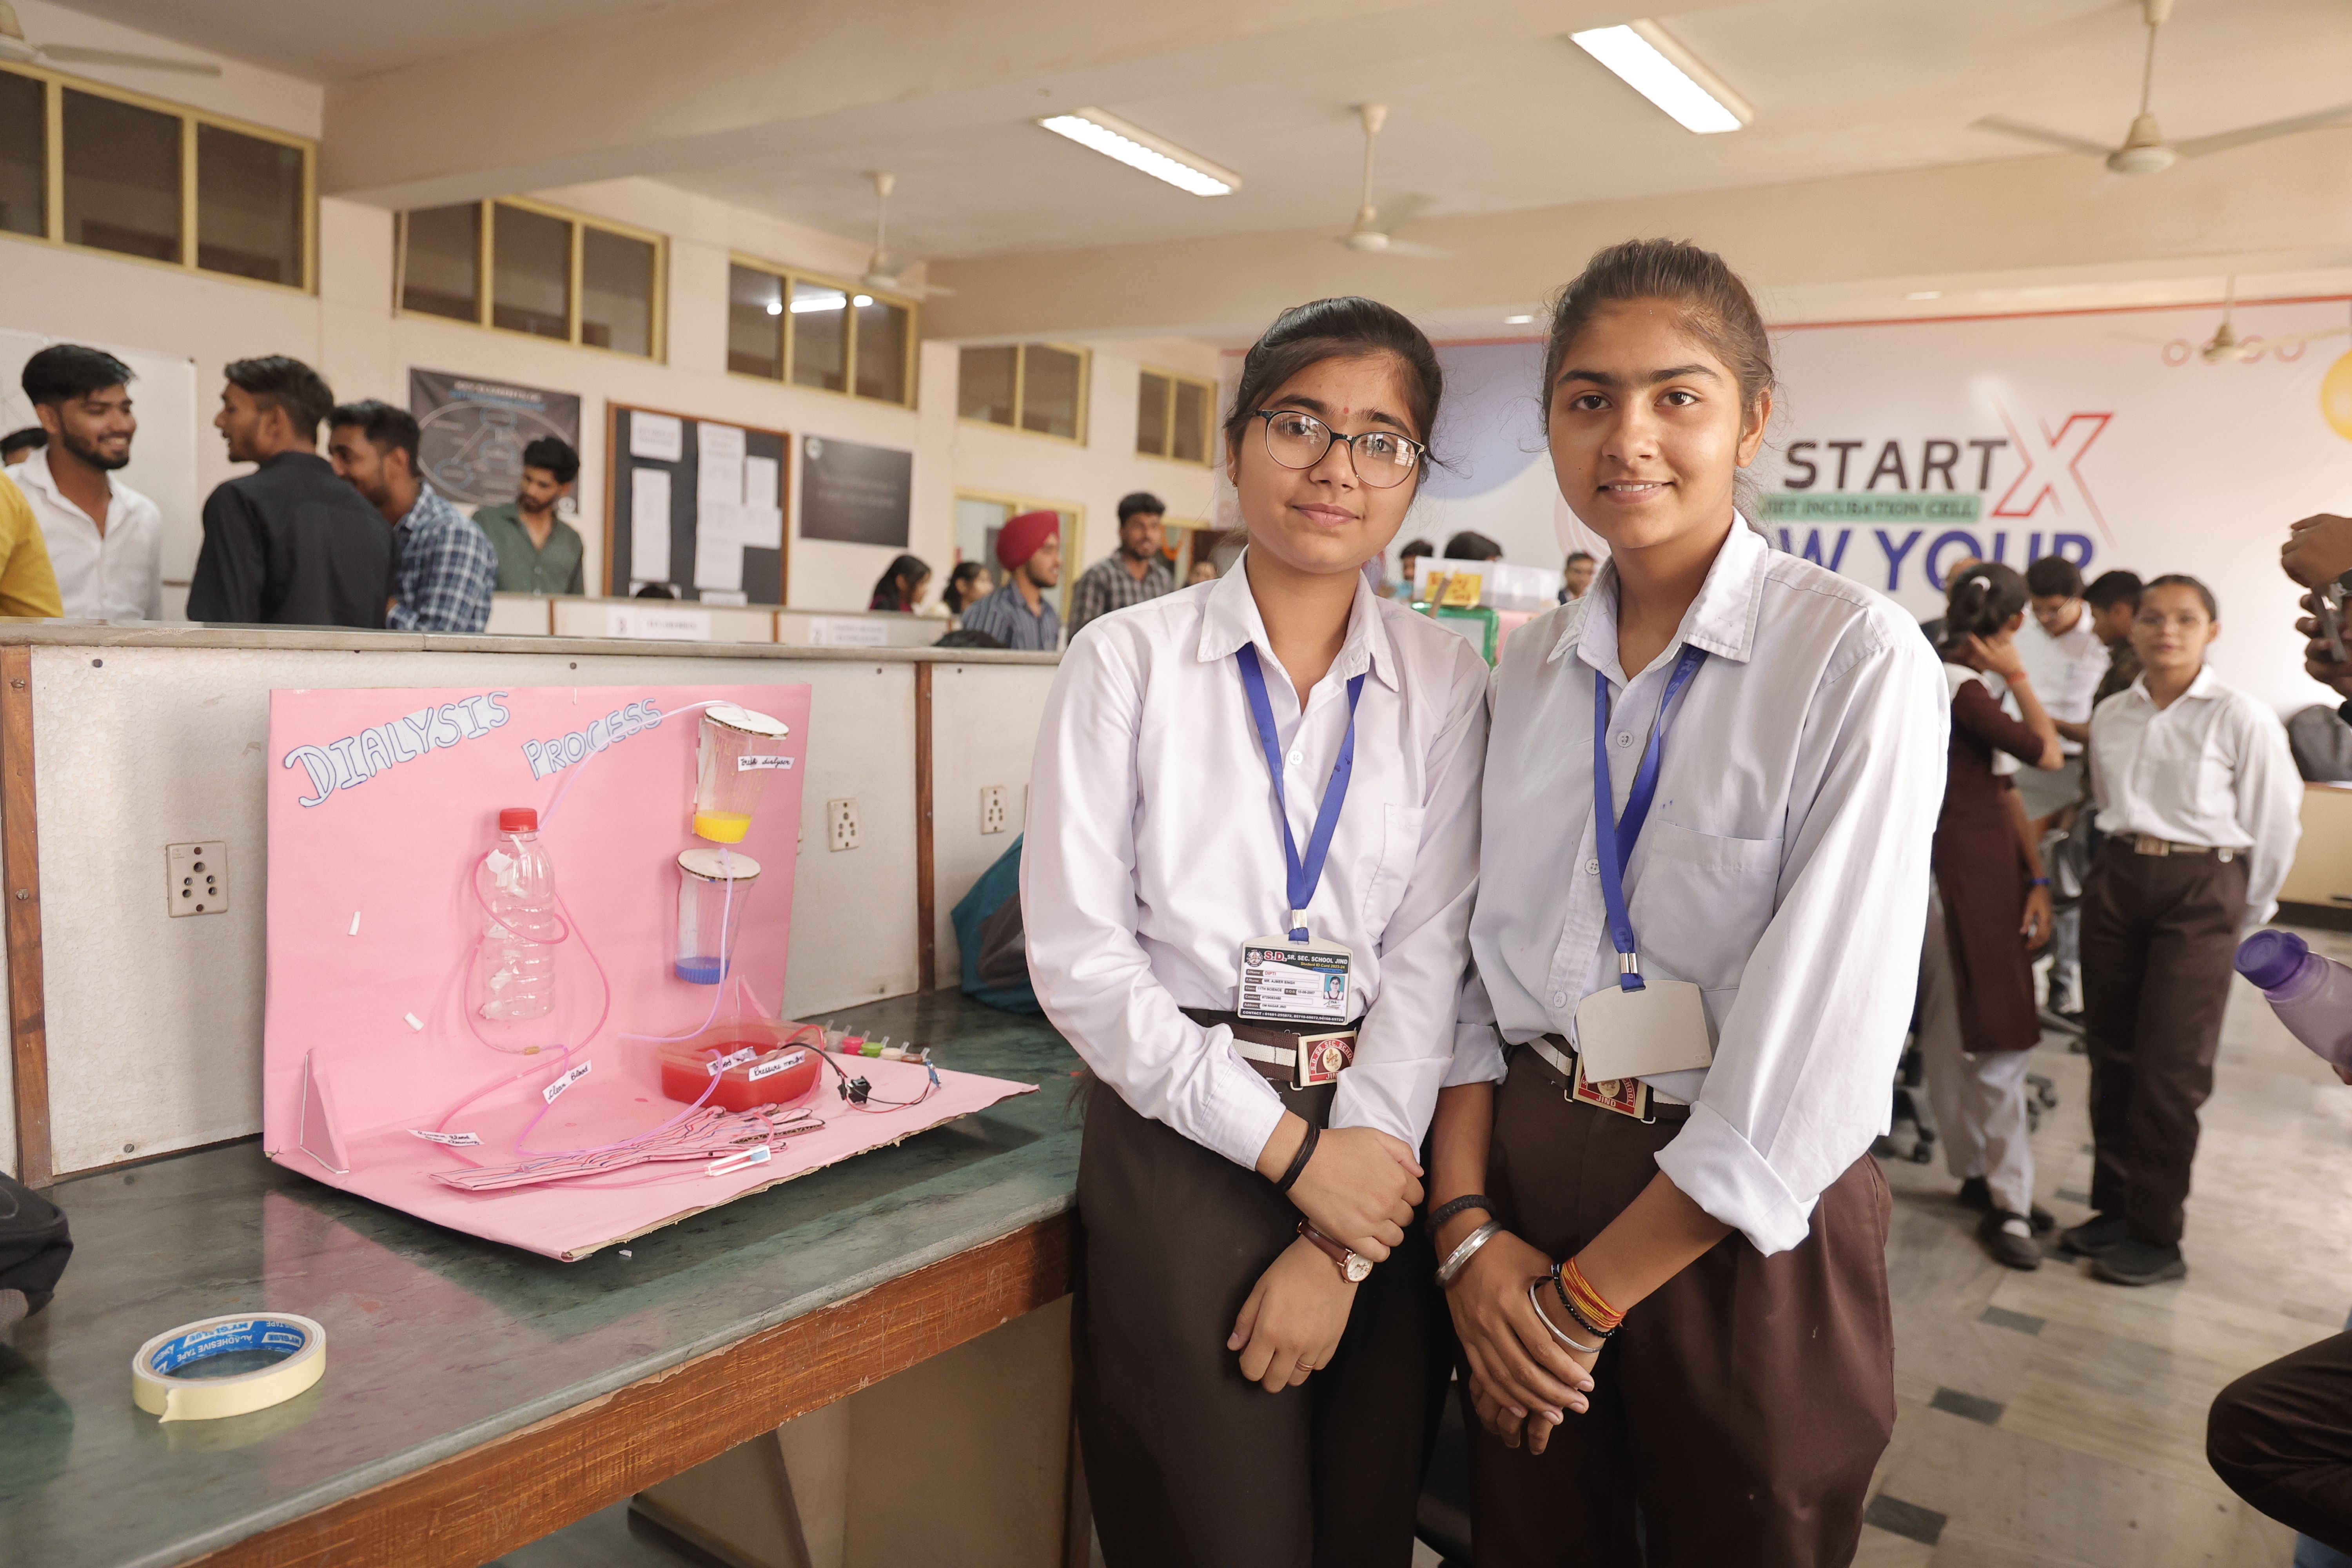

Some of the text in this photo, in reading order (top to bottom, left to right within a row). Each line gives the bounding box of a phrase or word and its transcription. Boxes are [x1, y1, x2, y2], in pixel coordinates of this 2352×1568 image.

[284, 691, 663, 808] DIALYSIS PROCESS
[1264, 951, 1287, 962] S.D.
[1315, 1046, 1324, 1056] SR.
[570, 1065, 589, 1081] Blood
[754, 1065, 781, 1076] Pressure
[1596, 1095, 1616, 1107] JIND
[177, 1347, 196, 1362] TAPE
